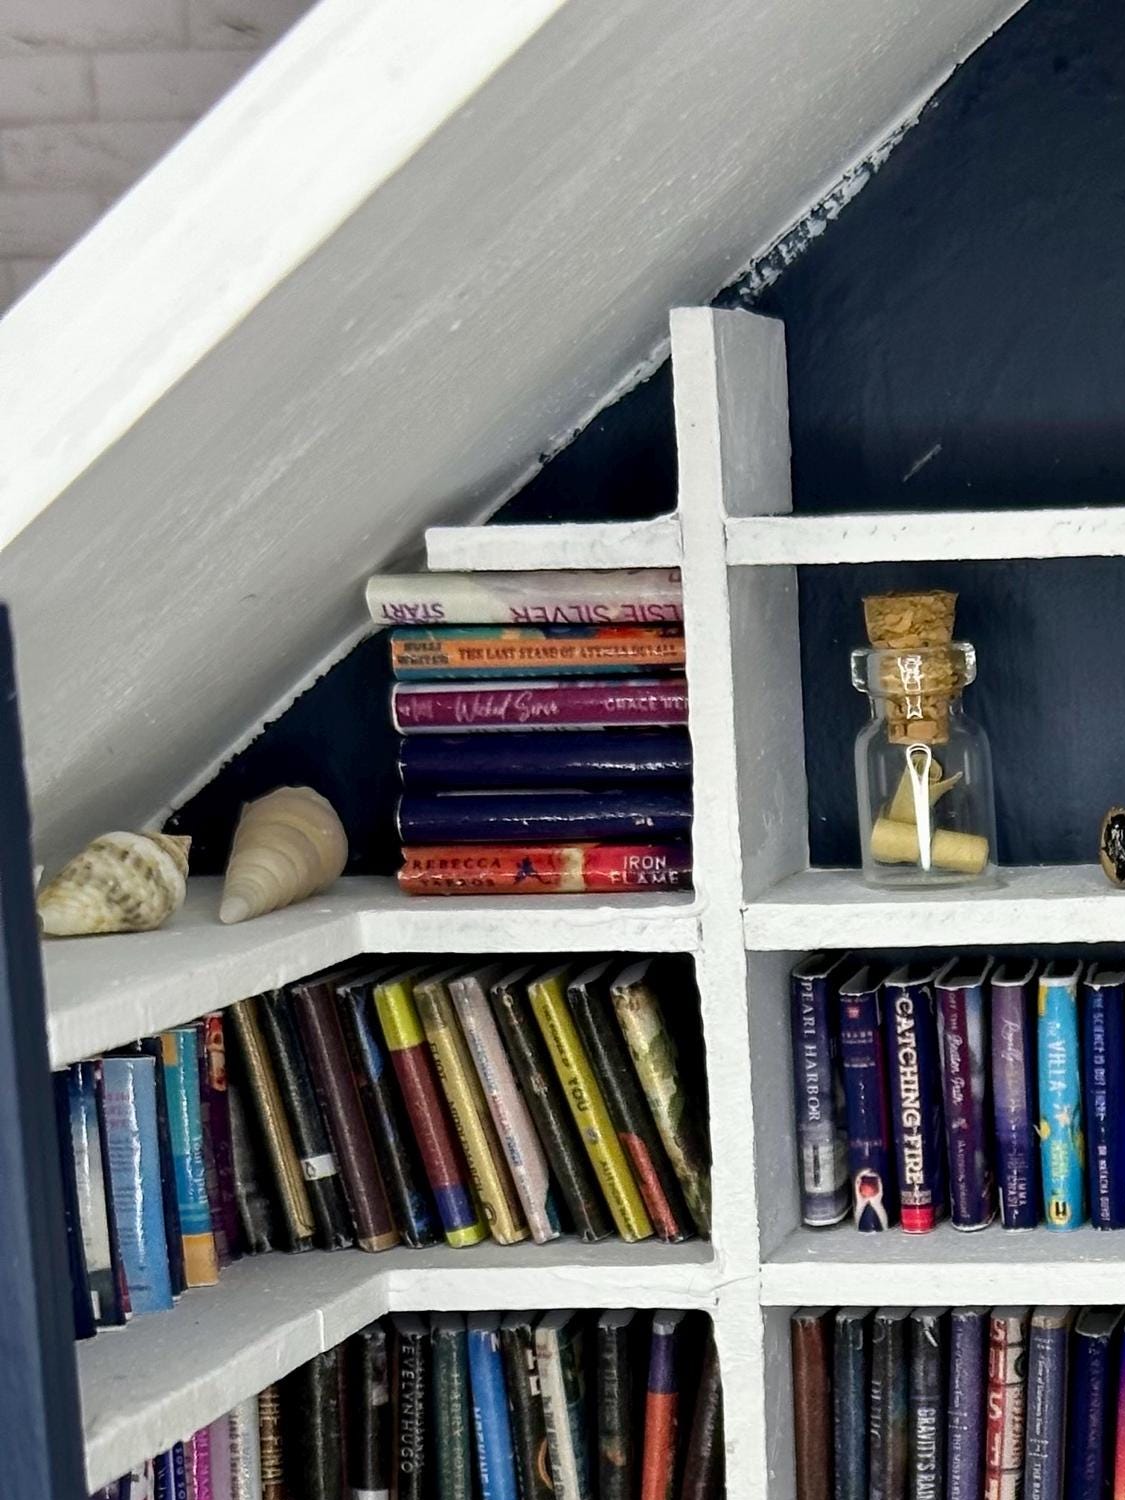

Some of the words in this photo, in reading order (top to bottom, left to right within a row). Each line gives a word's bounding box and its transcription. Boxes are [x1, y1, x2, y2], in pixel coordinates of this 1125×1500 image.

[379, 603, 446, 622] START
[619, 603, 682, 622] LSIE
[411, 856, 501, 871] REBECCA
[609, 871, 680, 885] FLAME
[622, 855, 667, 871] IRON
[799, 978, 817, 1038] PEARL
[803, 1043, 821, 1122] HARBOR
[895, 997, 922, 1129] CATCHING
[1047, 1042, 1067, 1092] VILLA
[567, 1076, 589, 1113] YOU
[902, 1134, 924, 1185] FIRE
[401, 1344, 416, 1424] EVELYN
[450, 1374, 463, 1437] HARRY
[400, 1426, 415, 1474] HUGO
[916, 1407, 938, 1471] GRAVITY'S
[951, 1433, 961, 1451] THE
[1032, 1482, 1042, 1500] BAD
[1033, 1462, 1043, 1481] THE
